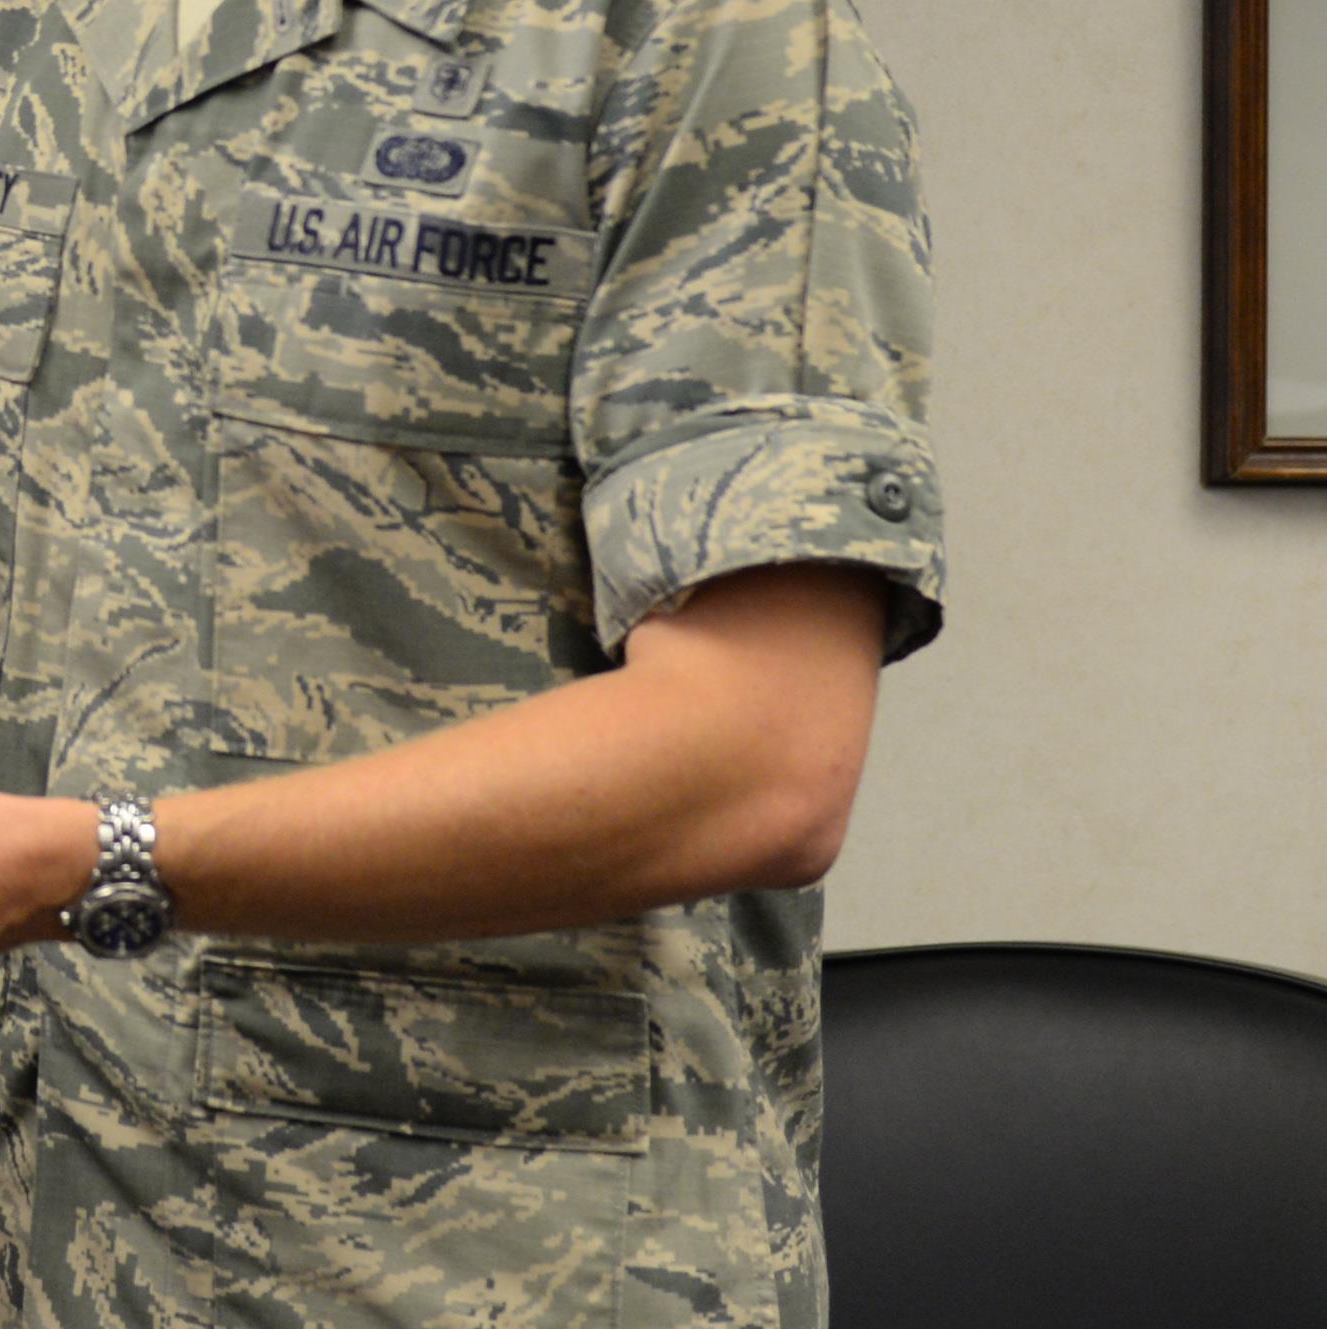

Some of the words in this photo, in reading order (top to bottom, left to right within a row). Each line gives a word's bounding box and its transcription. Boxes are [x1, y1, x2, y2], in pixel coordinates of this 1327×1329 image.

[268, 202, 326, 255] U.S.
[333, 212, 405, 269] AIR
[413, 222, 557, 287] FORCE
